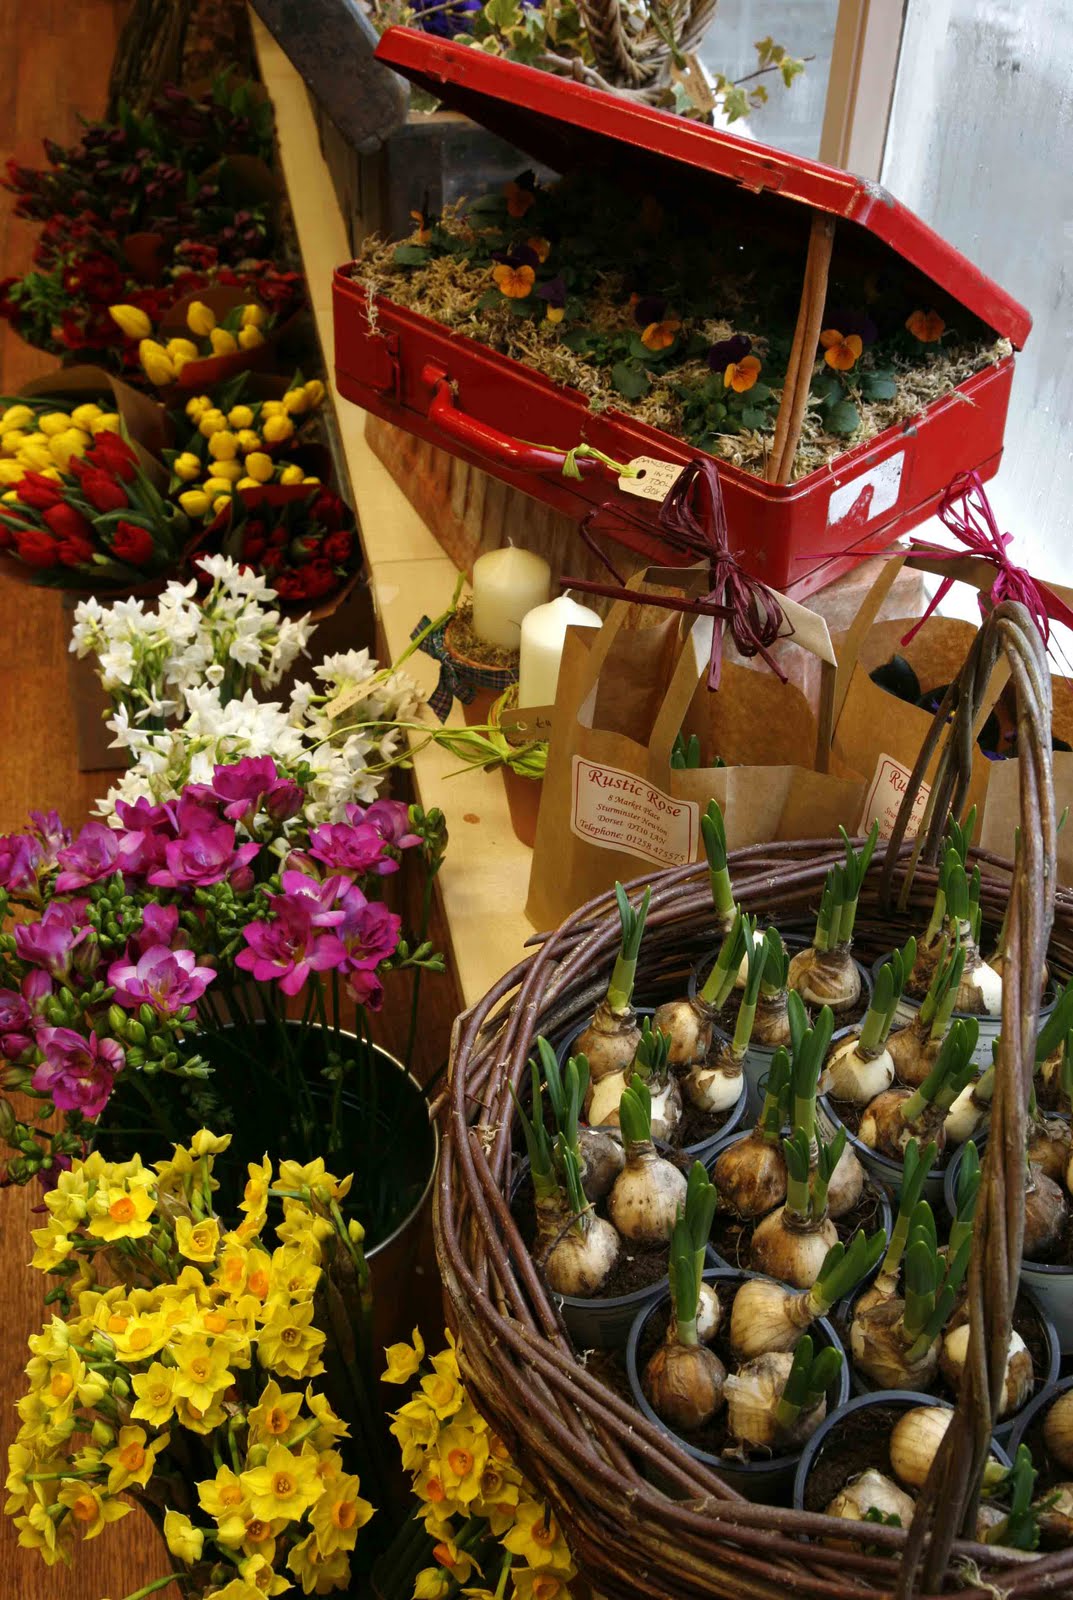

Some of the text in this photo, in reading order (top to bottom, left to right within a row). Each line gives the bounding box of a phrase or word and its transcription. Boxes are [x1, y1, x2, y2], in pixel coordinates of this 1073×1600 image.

[588, 769, 681, 817] Rustic Rose
[615, 796, 642, 810] Market
[643, 808, 660, 821] Place
[596, 804, 668, 836] Sturminster Newton
[597, 814, 624, 826] Dorset
[627, 823, 648, 835] DT10
[580, 819, 685, 862] Telephone: 01258 475575
